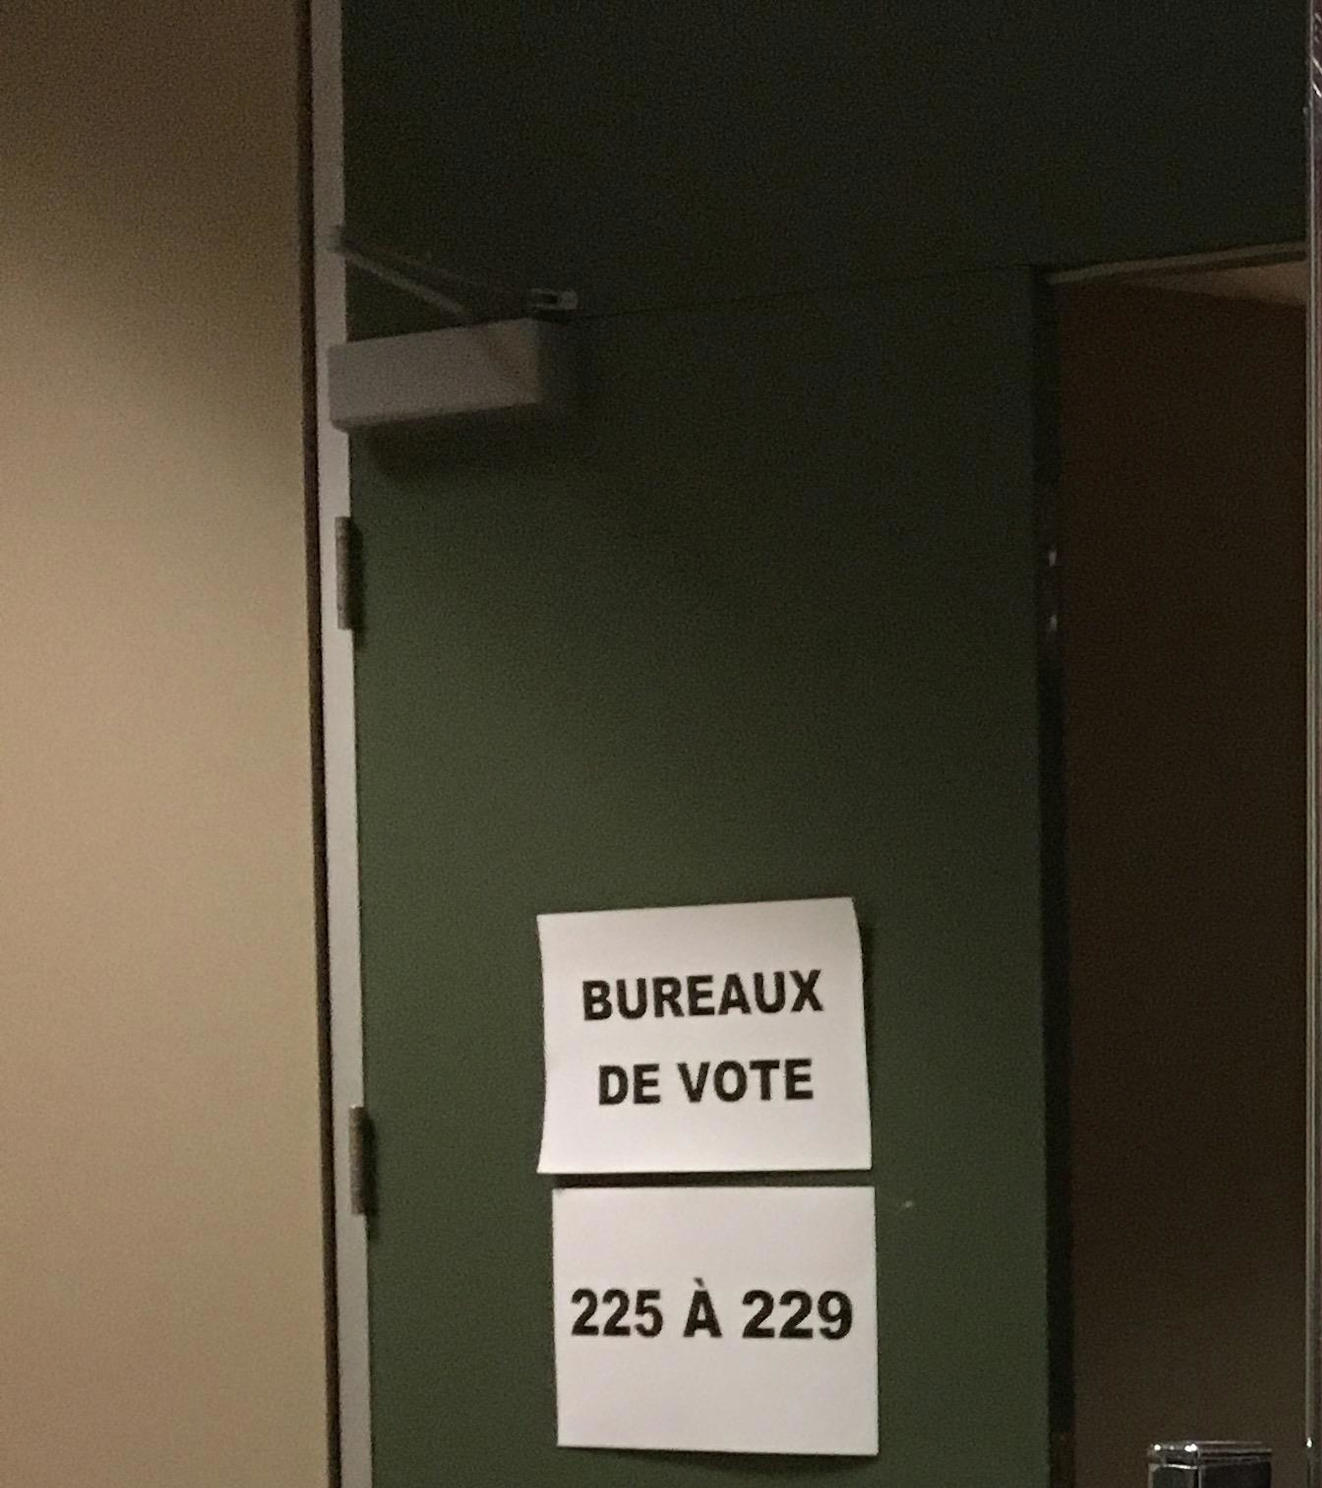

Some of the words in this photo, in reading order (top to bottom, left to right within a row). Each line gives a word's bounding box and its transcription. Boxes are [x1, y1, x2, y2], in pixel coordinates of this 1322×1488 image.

[581, 969, 825, 1021] BUREAUX
[597, 1063, 662, 1106] DE
[677, 1058, 815, 1103] VOTE
[570, 1288, 665, 1338] 225
[682, 1278, 723, 1338] À
[741, 1289, 853, 1341] 229
